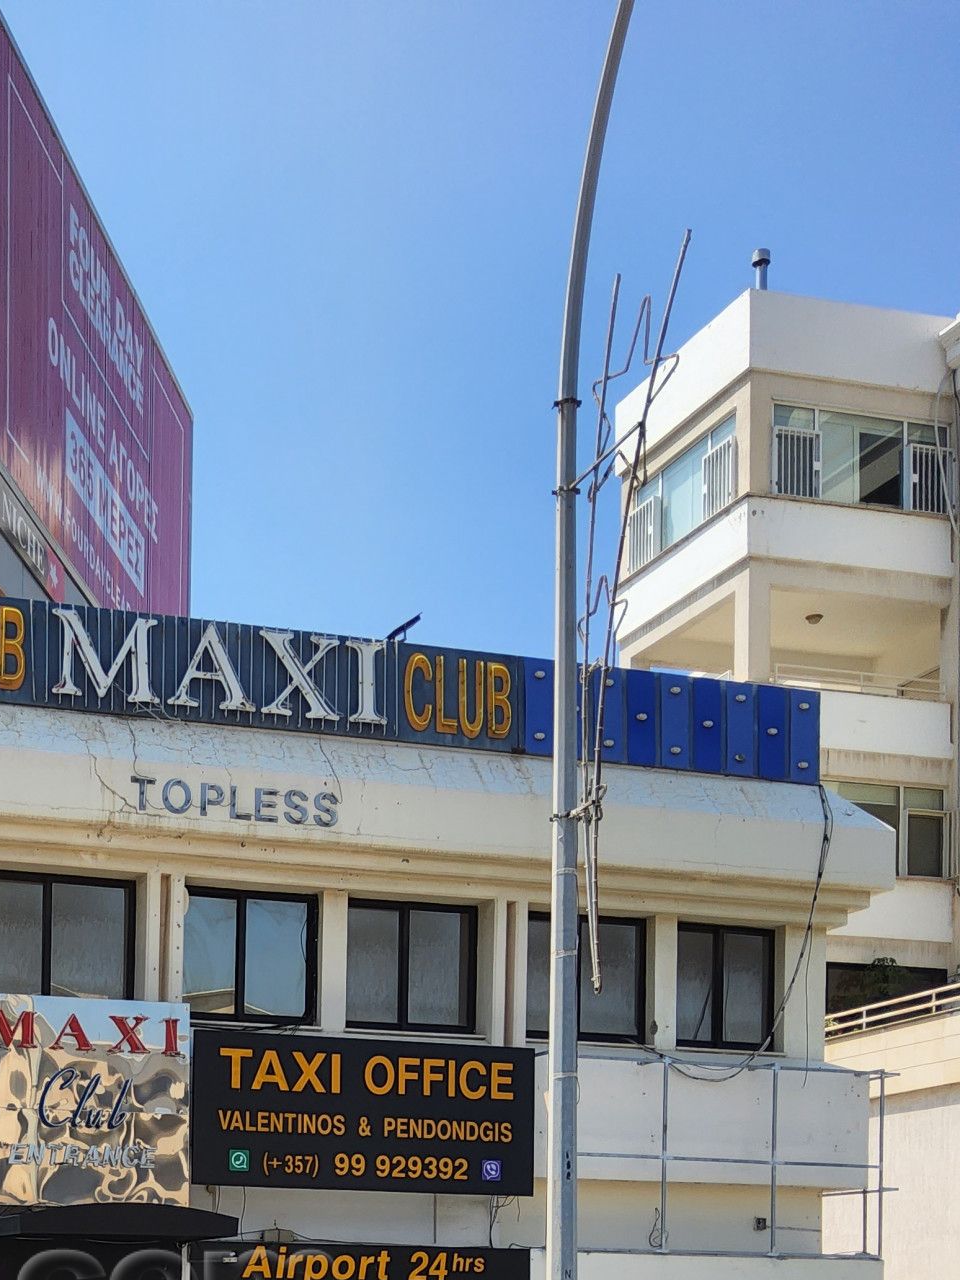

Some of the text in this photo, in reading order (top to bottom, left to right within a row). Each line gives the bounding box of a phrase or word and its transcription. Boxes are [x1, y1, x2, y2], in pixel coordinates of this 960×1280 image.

[69, 202, 144, 366] FOUR DAY
[69, 250, 143, 417] CLEARANCE
[48, 317, 106, 453] ONLINE
[70, 431, 94, 503] 365
[2, 492, 46, 575] NICHE
[51, 606, 388, 726] MAXI
[404, 652, 512, 739] CLUB
[131, 775, 340, 828] TOPLESS
[38, 1066, 134, 1130] Club
[220, 1047, 515, 1100] TAXI OFFICE
[8, 1143, 158, 1169] ENTRANCE
[218, 1110, 513, 1143] VALENTINOS & PENDONDGIS
[263, 1152, 469, 1180] (+357) 99 929392
